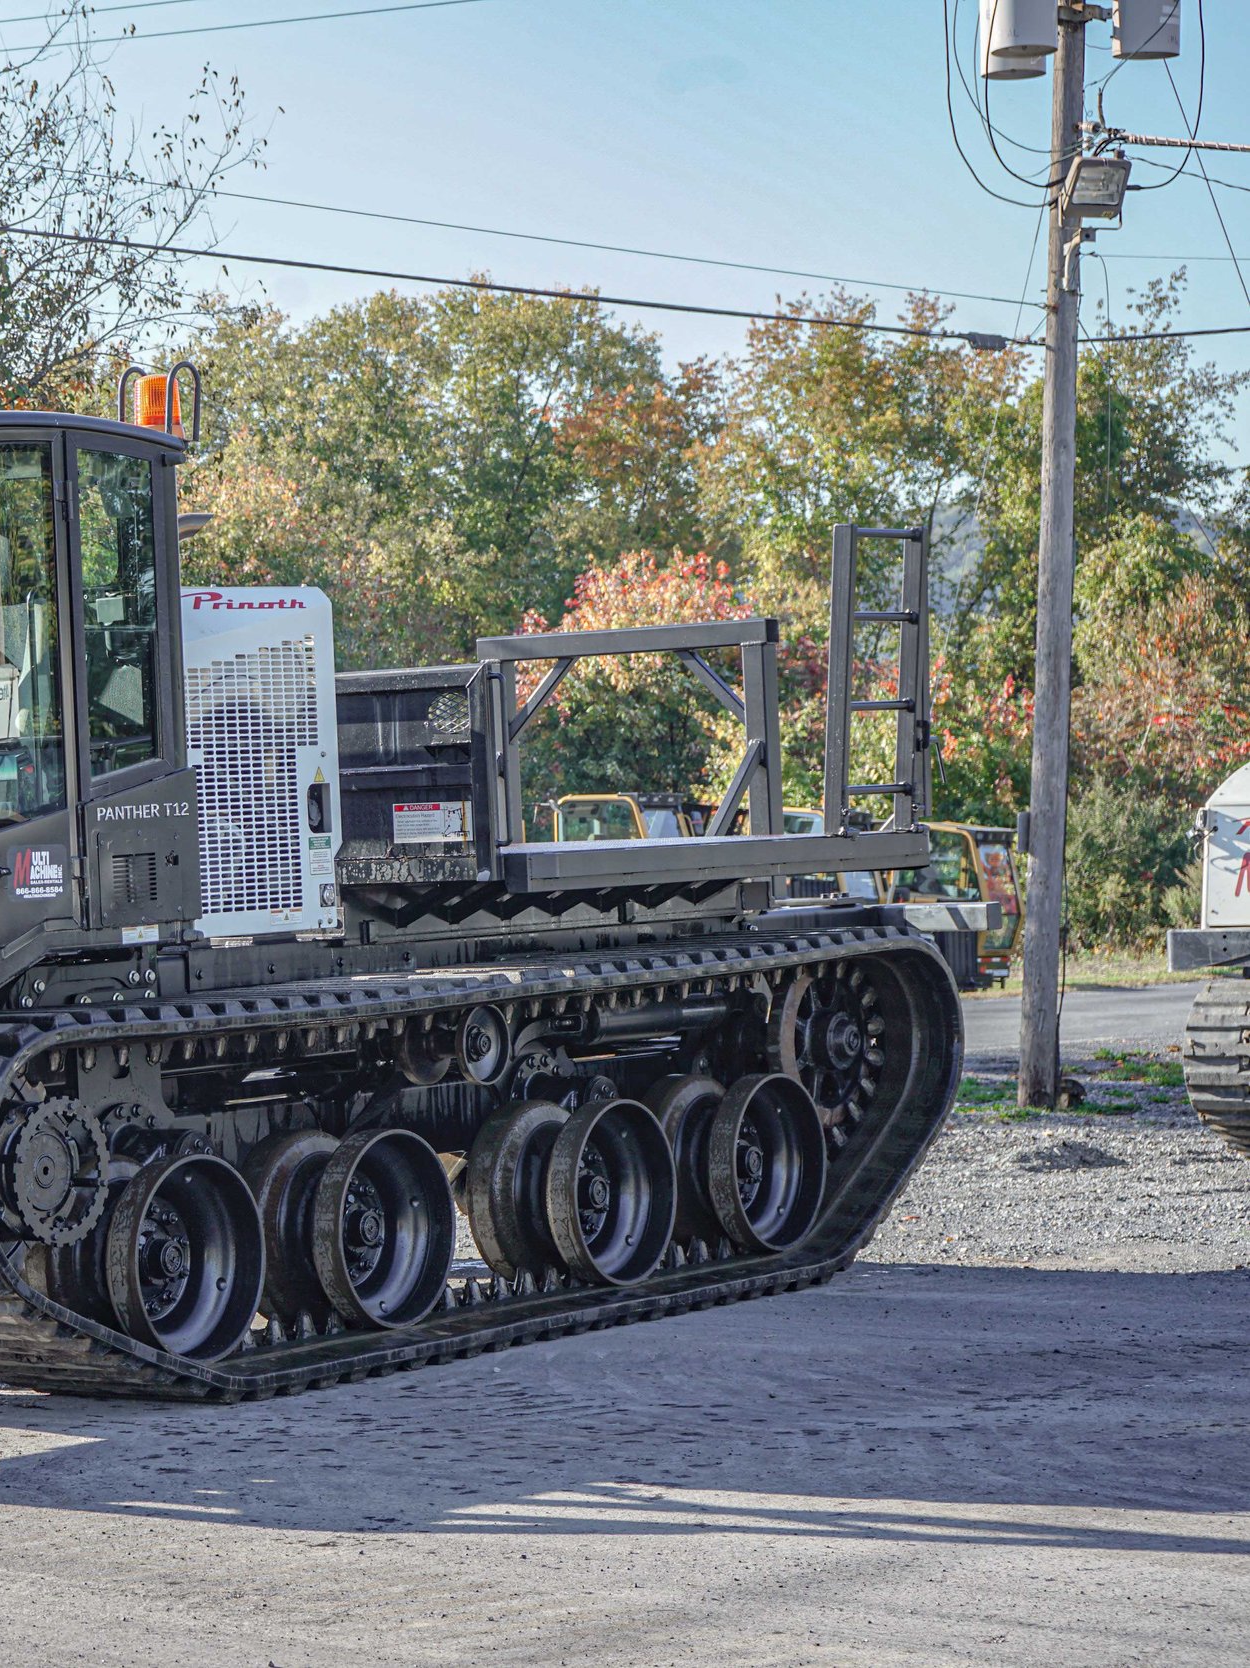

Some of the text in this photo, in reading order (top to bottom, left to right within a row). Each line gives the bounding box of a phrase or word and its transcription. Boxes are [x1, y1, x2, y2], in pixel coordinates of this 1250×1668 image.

[181, 592, 306, 609] Prinoth
[96, 802, 190, 821] PANTHER T12
